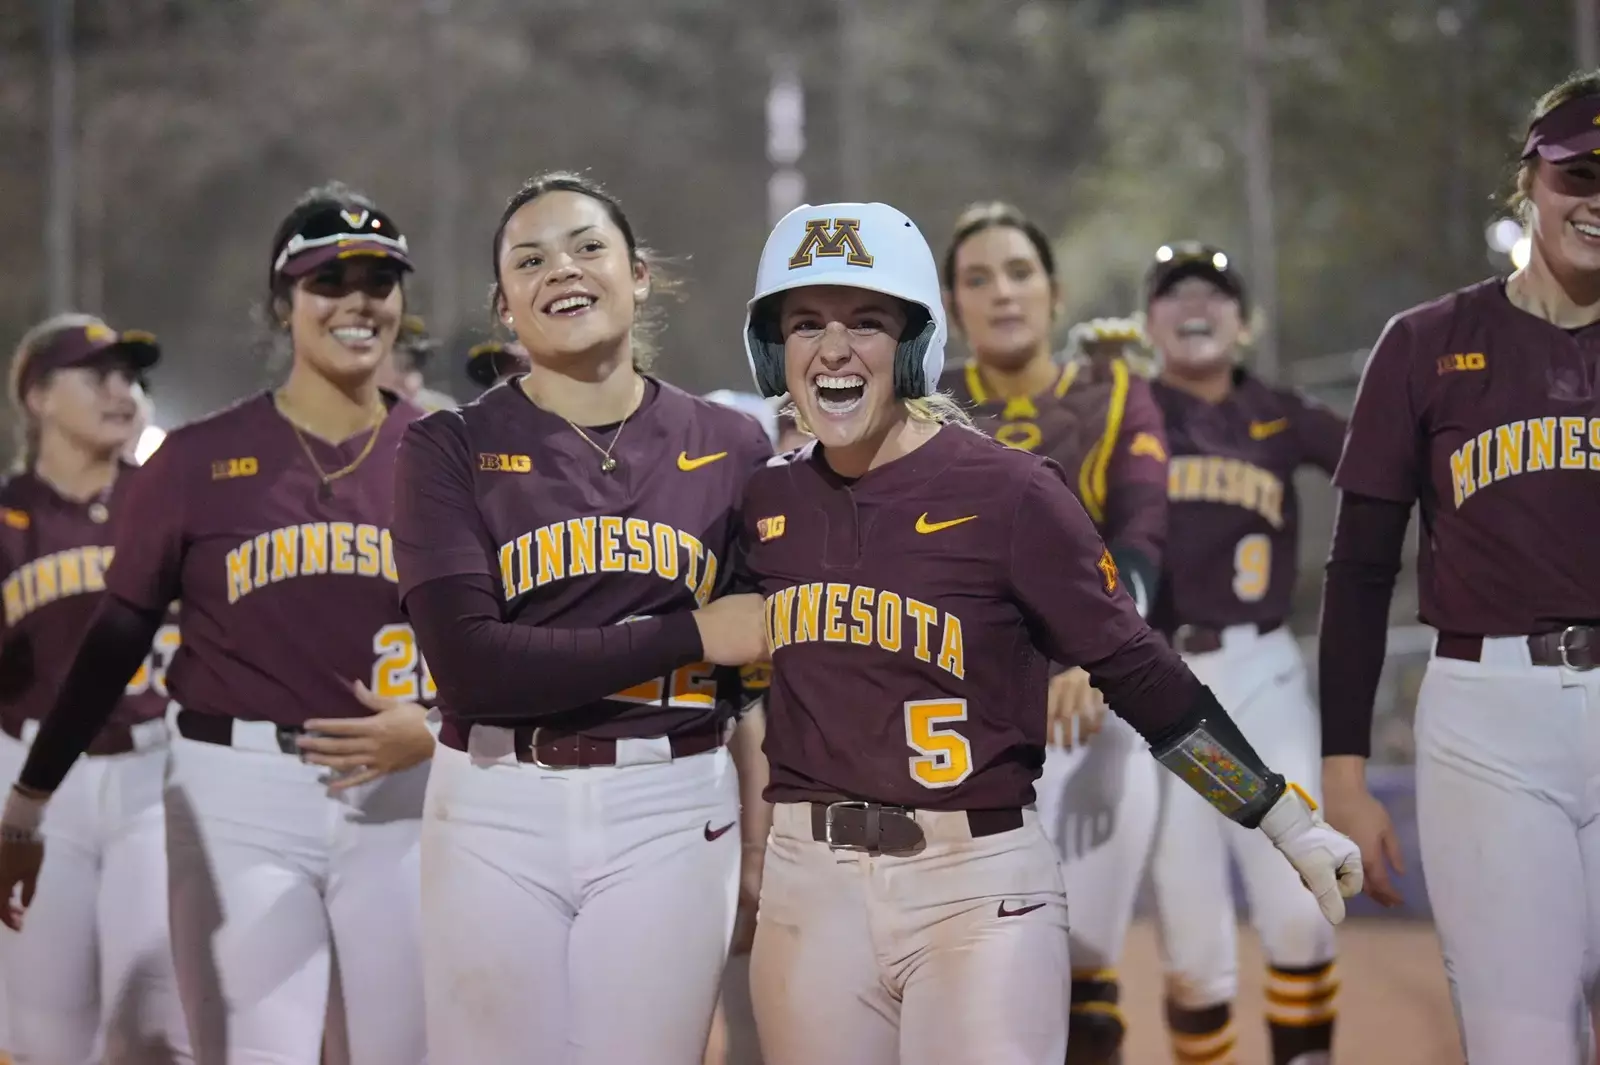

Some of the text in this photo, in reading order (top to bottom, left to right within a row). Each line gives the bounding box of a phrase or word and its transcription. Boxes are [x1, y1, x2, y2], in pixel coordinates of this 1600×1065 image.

[788, 218, 874, 270] M
[1232, 533, 1272, 603] 9
[763, 582, 964, 680] INNESOTA
[904, 698, 973, 789] 5
